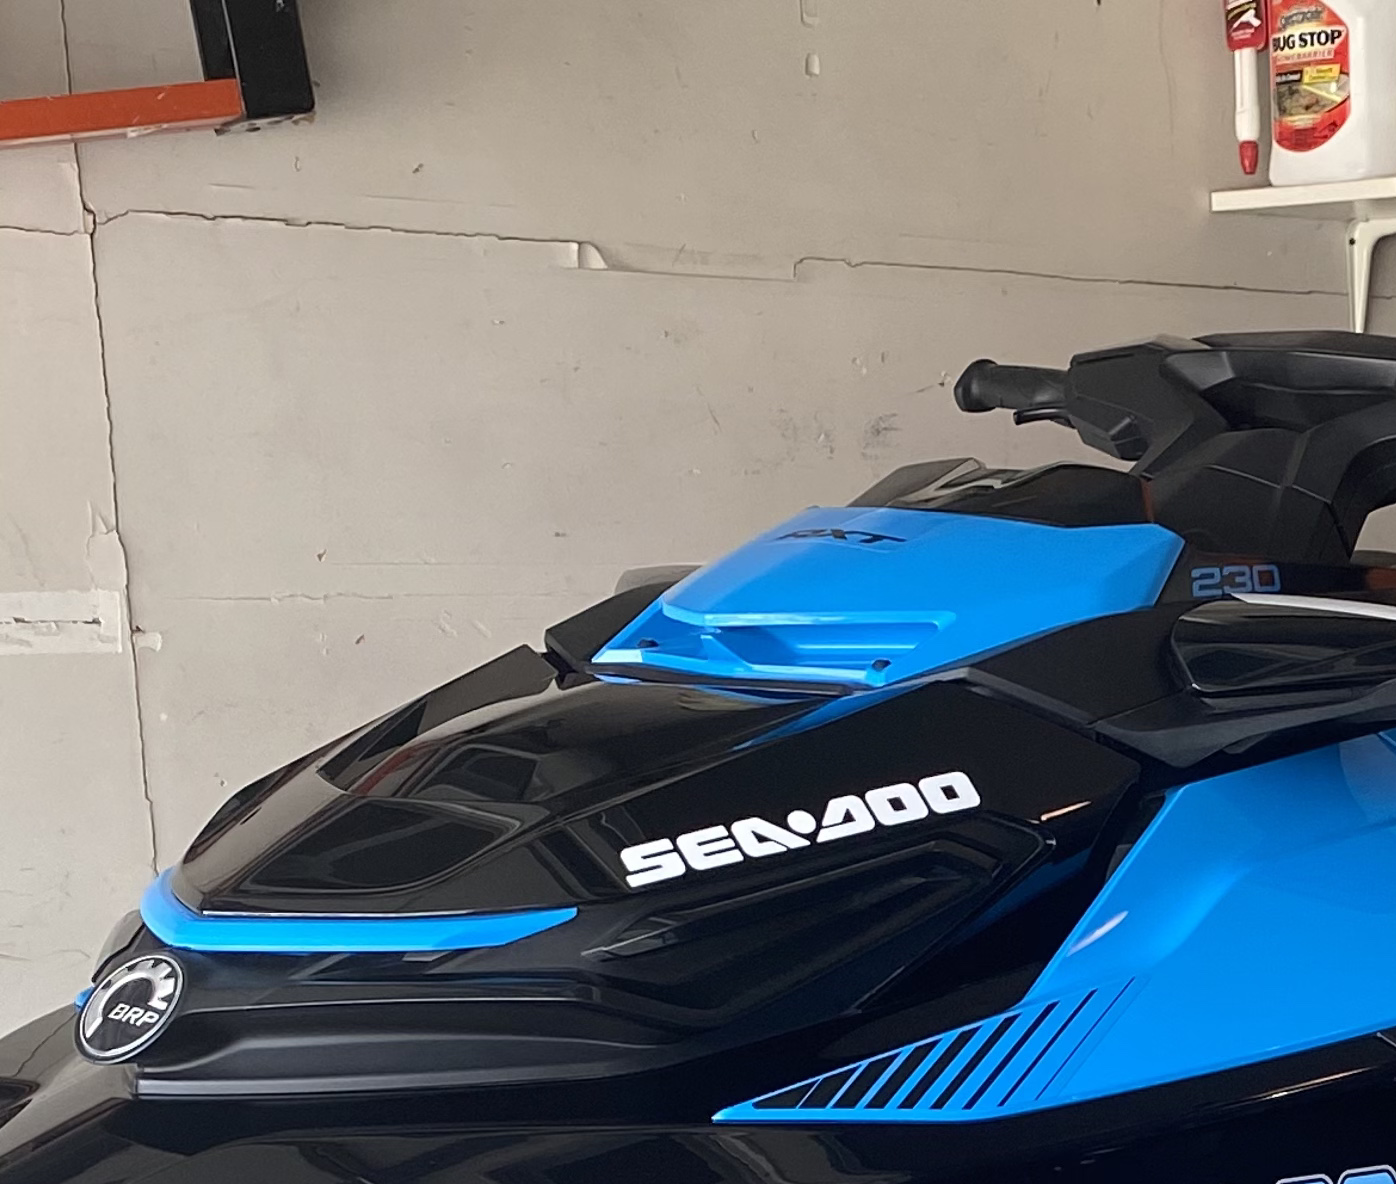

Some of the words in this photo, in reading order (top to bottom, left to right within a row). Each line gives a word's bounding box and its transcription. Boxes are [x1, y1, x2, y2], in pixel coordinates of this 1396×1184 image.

[1299, 29, 1342, 48] STOP
[1191, 563, 1281, 598] 230
[108, 1003, 160, 1027] BRP
